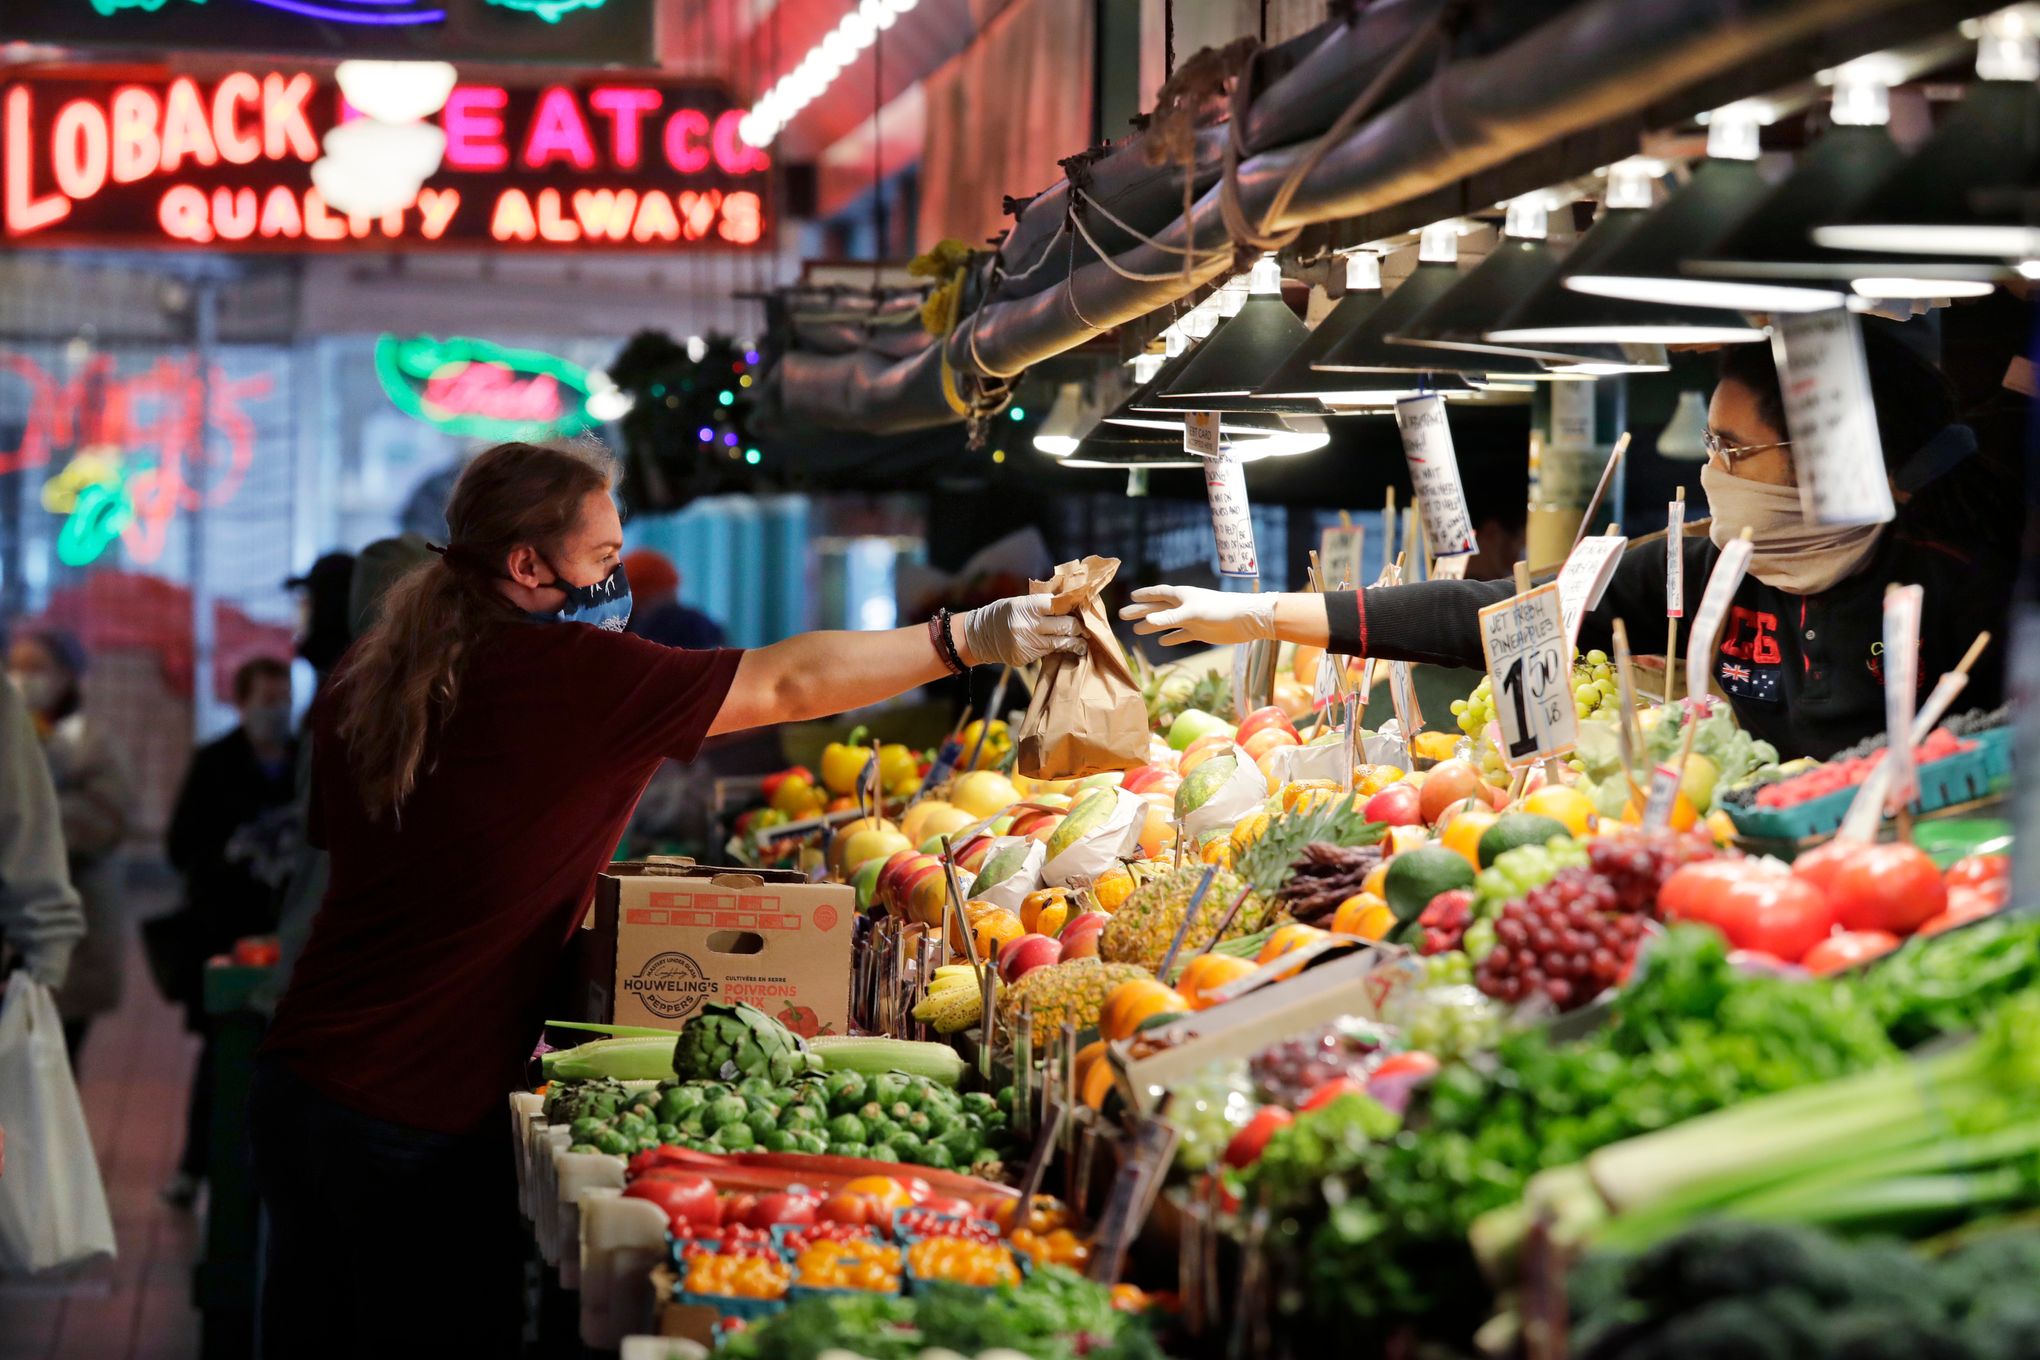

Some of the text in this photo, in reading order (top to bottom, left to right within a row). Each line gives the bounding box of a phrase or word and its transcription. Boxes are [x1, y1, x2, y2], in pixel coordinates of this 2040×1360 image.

[4, 70, 319, 234] LOBACK
[341, 87, 662, 168] EAT
[491, 187, 763, 244] ALWAYS
[1489, 611, 1508, 635] JET
[1489, 618, 1554, 657] PINEAPPLES
[646, 958, 666, 977] MASTERY
[666, 957, 685, 967] UNDER
[624, 979, 719, 993] HOUWELING'S
[724, 983, 797, 997] POIVRONS
[647, 994, 694, 1012] PEPPERS
